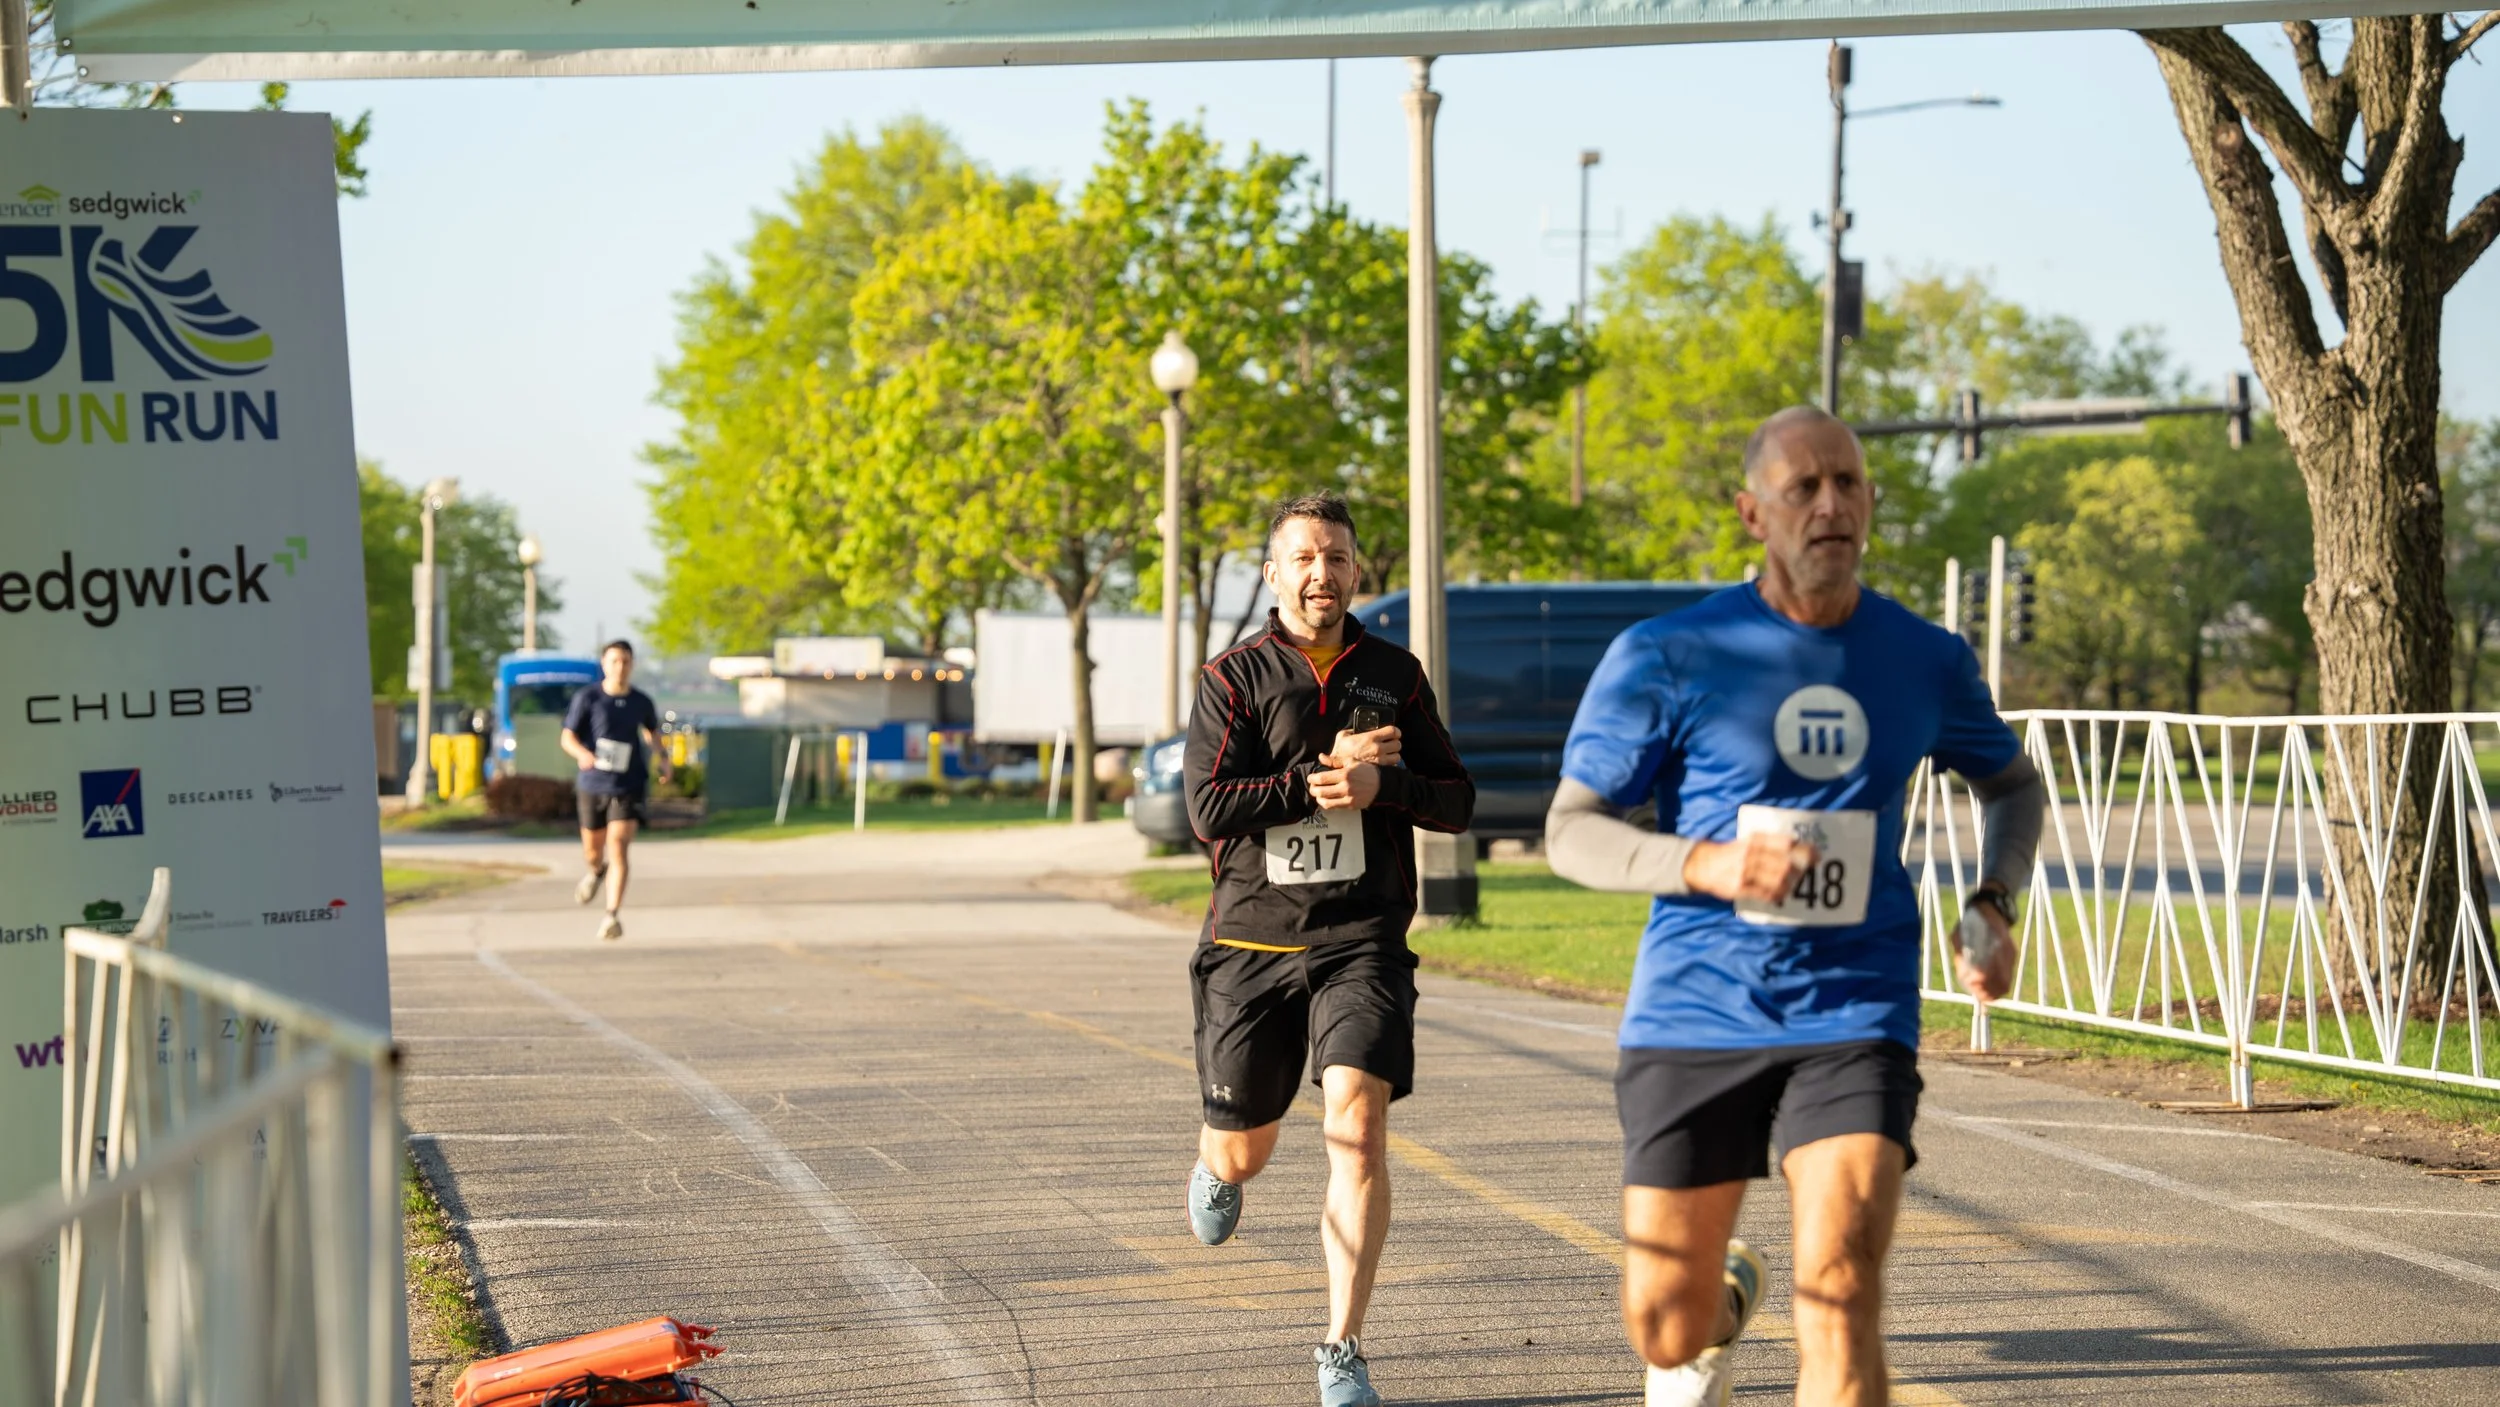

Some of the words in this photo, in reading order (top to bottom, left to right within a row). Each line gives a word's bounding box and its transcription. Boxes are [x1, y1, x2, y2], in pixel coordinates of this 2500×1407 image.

[69, 191, 188, 220] sedgwick
[0, 225, 273, 382] 5K
[0, 392, 129, 444] FUN
[141, 389, 279, 443] RUN
[25, 685, 253, 724] CHUBB
[1356, 688, 1398, 705] COMPASS
[0, 790, 57, 804] LLIED
[168, 788, 254, 805] DESCARTES
[83, 803, 135, 833] AXA
[1287, 833, 1342, 872] 217
[1777, 859, 1844, 909] 48
[262, 906, 333, 925] TRAVELERS
